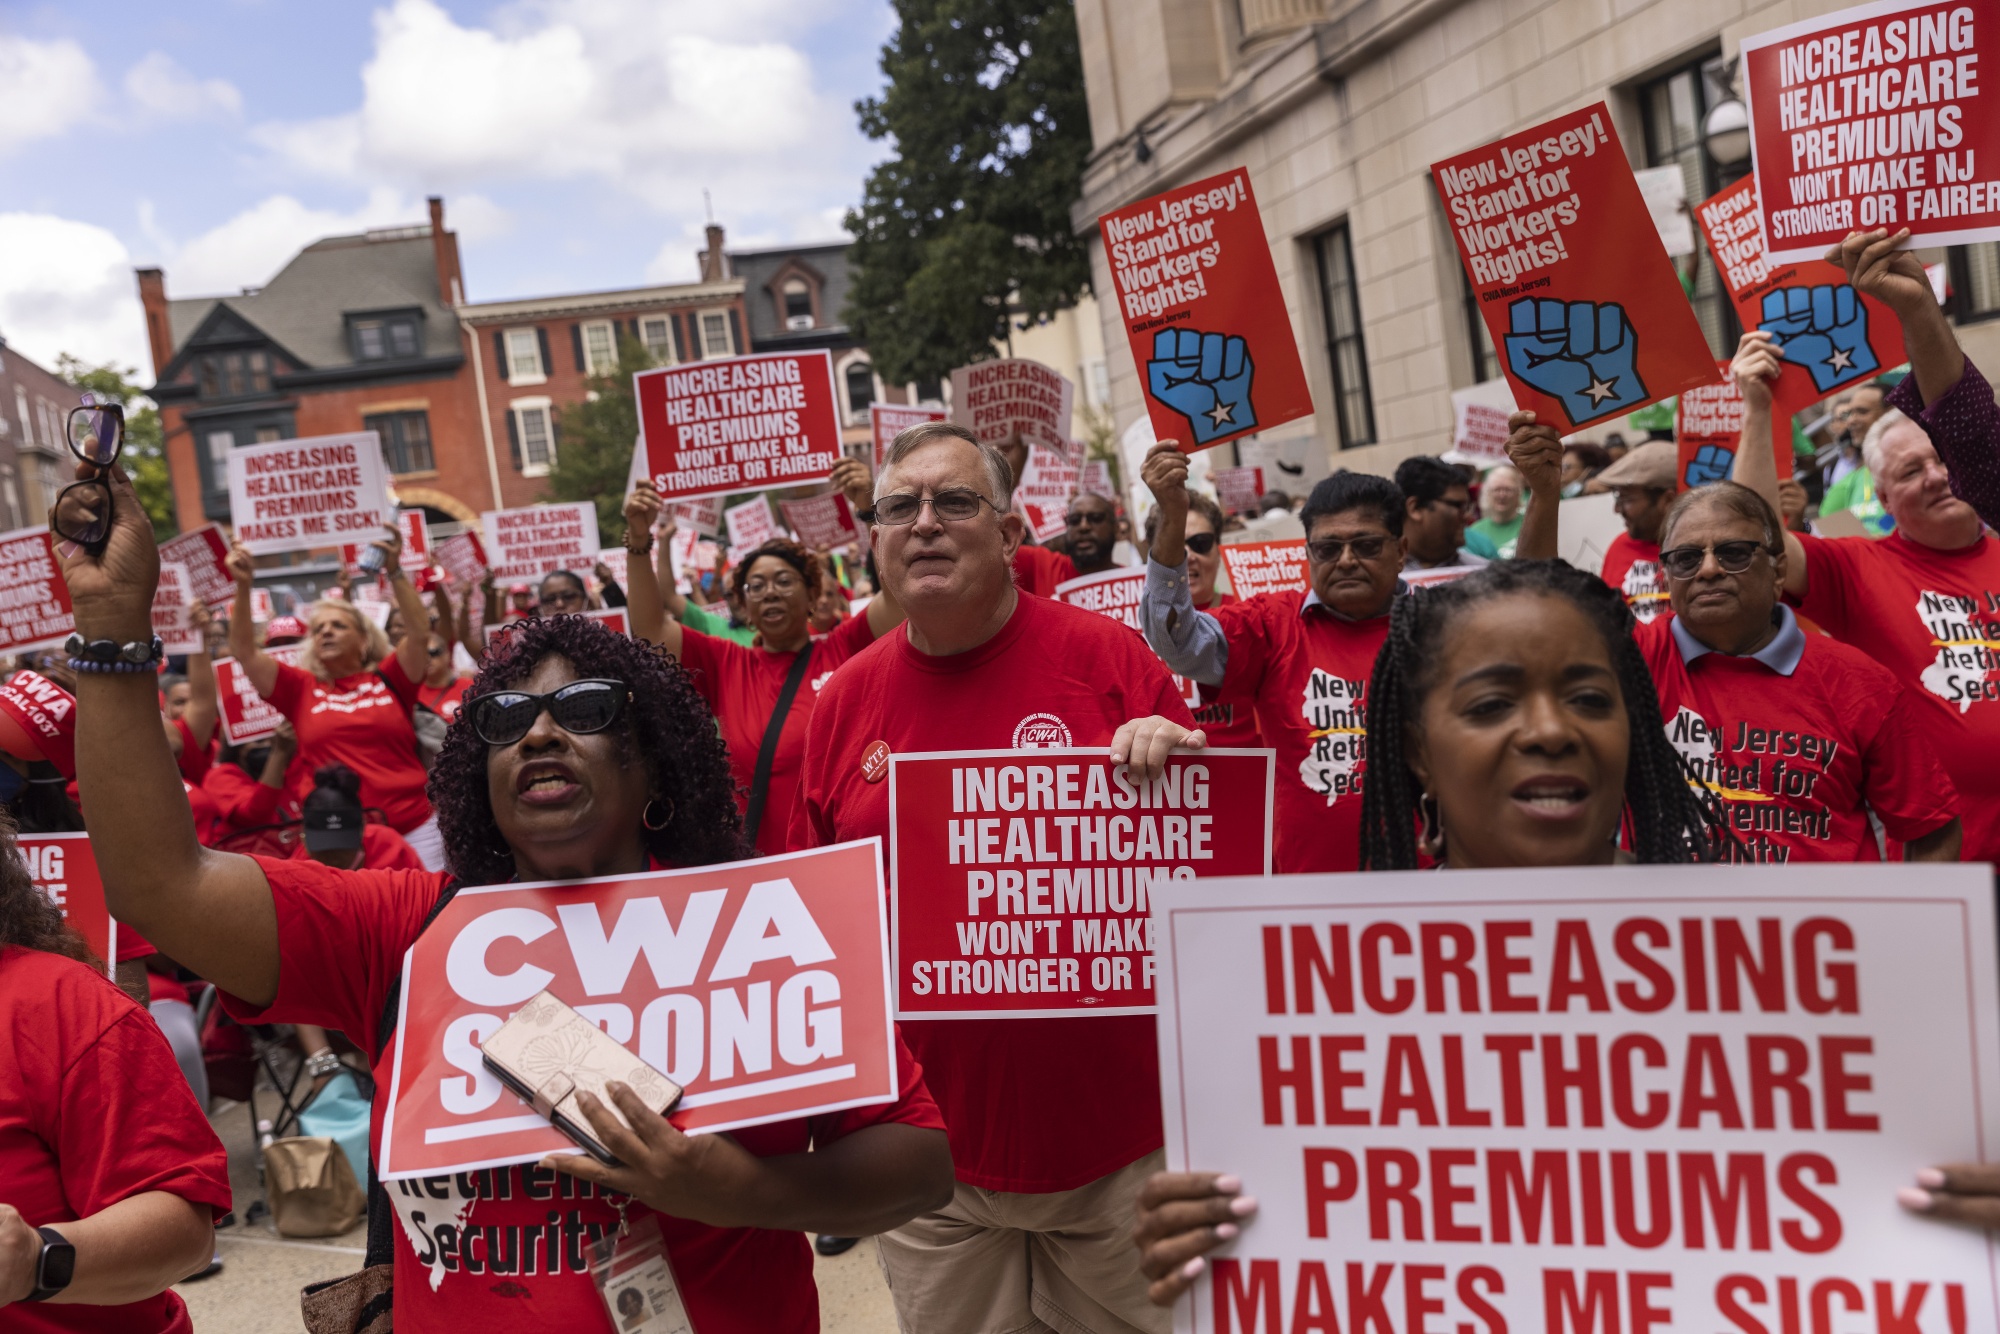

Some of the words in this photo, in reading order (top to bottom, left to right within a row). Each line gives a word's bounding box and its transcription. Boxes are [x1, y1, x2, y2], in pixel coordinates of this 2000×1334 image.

[1779, 6, 1974, 88] INCREASING
[1779, 53, 1979, 131] HEALTHCARE
[1440, 159, 1498, 199] New
[1498, 112, 1609, 181] Jersey!
[1790, 105, 1963, 173] PREMIUMS
[1450, 175, 1528, 227] Stand
[1525, 166, 1571, 202] for
[1789, 168, 1843, 205] WON'T
[1848, 156, 1926, 196] MAKE
[1935, 149, 1975, 185] NJ
[1105, 210, 1155, 245] New
[1155, 175, 1247, 228] Jersey!
[1701, 187, 1752, 230] New
[1772, 199, 1853, 239] STRONGER
[1860, 194, 1897, 227] OR
[1112, 225, 1181, 269] Stand
[1178, 217, 1215, 245] for
[1710, 209, 1761, 249] Stan
[1469, 230, 1569, 285] Rights!
[1124, 271, 1207, 319] Rights!
[1482, 289, 1501, 303] CWA
[1500, 286, 1519, 298] New
[1520, 276, 1551, 293] Jersey
[1165, 310, 1191, 323] Jersey
[665, 359, 801, 399] INCREASING
[968, 363, 1062, 395] INCREASING
[666, 384, 807, 425] HEALTHCARE
[967, 383, 1062, 416] HEALTHCARE
[974, 402, 1058, 429] PREMIUMS
[677, 411, 800, 450] PREMIUMS
[973, 422, 1007, 441] AKES
[1012, 420, 1036, 437] ME
[245, 444, 357, 475] INCREASING
[655, 463, 740, 493] STRONGER
[744, 459, 768, 480] OR
[770, 451, 834, 477] FAIRER!
[675, 446, 728, 470] WON'T
[732, 438, 782, 463] MAKE
[786, 435, 809, 455] NJ
[245, 467, 362, 497] HEALTHCARE
[254, 490, 358, 519] PREMIUMS
[496, 508, 582, 530] INCREASING
[239, 519, 297, 542] MAKES
[302, 515, 330, 535] ME
[334, 511, 382, 531] SICK!
[497, 525, 584, 546] HEALTHCARE
[1225, 548, 1262, 566] New
[1263, 545, 1307, 564] Jerse
[1231, 563, 1278, 584] Stand
[1278, 563, 1302, 579] for
[1068, 578, 1147, 611] INCREASIN
[1923, 592, 1979, 616] New
[1929, 619, 2000, 642] Unite
[14, 670, 72, 722] CWA
[1312, 674, 1366, 701] New
[0, 686, 31, 711] OCAL
[27, 706, 60, 738] 1037
[1314, 704, 1367, 730] Unit
[1027, 728, 1058, 741] CWA
[1672, 712, 1725, 754] New
[1731, 721, 1838, 775] Jersey
[862, 745, 884, 774] WTF
[1771, 760, 1820, 799] for
[952, 764, 1210, 813] INCREASING
[948, 815, 1213, 865] HEALTHCARE
[967, 865, 1196, 916] PREMIU
[446, 877, 837, 1007] CWA
[956, 920, 1061, 956] WON'T
[912, 958, 1081, 995] STRONGER
[1091, 956, 1132, 991] OR
[1261, 916, 1861, 1015] INCREASING
[439, 969, 844, 1115] SONG
[1258, 1032, 1881, 1132] HEALTHCARE
[1303, 1146, 1844, 1254] PREMIUMS
[1210, 1258, 1507, 1334] MAKES
[1542, 1268, 1675, 1334] ME
[1714, 1273, 1967, 1334] SICK!
